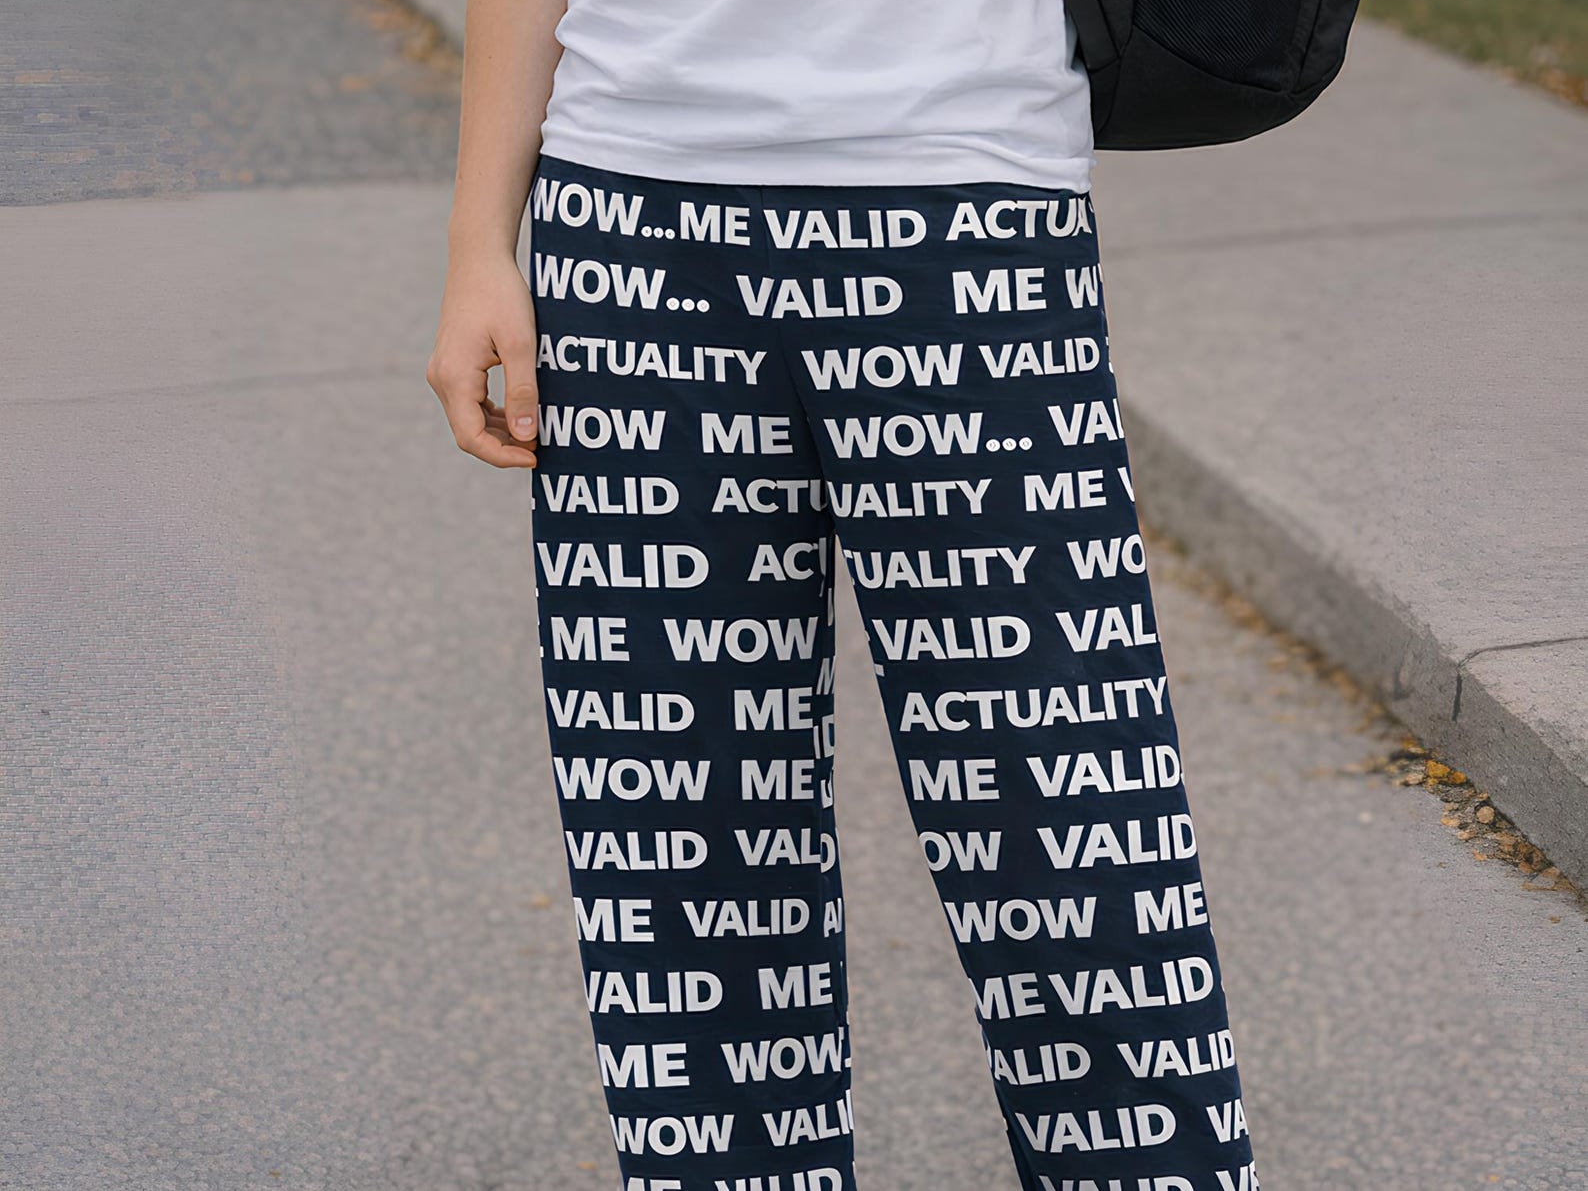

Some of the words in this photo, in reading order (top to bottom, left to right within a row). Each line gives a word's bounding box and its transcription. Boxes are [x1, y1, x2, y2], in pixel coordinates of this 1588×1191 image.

[764, 209, 927, 249] VALID
[736, 275, 903, 319] VALID
[952, 268, 1046, 314] ME
[536, 334, 767, 385] ACTUALITY
[801, 344, 963, 390] WOW
[978, 337, 1100, 378] VALID
[538, 404, 666, 450] WOW
[701, 413, 793, 454] ME
[823, 412, 1033, 459] WOW...
[541, 474, 679, 515] VALID
[1024, 470, 1107, 511] ME
[536, 543, 709, 588] VALID
[550, 616, 630, 661] ME
[662, 616, 819, 662] WOW
[871, 616, 1031, 660] VALID
[1056, 604, 1156, 652] VAL
[547, 688, 695, 732] VALID
[734, 687, 813, 731] ME
[900, 676, 1167, 731] ACTUALITY
[553, 757, 711, 800] WOW
[741, 760, 815, 800] ME
[909, 759, 1000, 801] ME
[1026, 745, 1180, 797] VALID
[565, 830, 708, 870] VALID
[1037, 814, 1198, 869] VALID
[573, 897, 654, 942] ME
[682, 899, 809, 938] VALID
[944, 897, 1096, 943] WOW
[1134, 882, 1208, 934] ME
[758, 962, 833, 1010] ME
[1048, 956, 1214, 1015] VALID
[597, 1043, 690, 1088] ME
[1117, 1029, 1235, 1078] VALID
[1015, 1104, 1176, 1153] VALID
